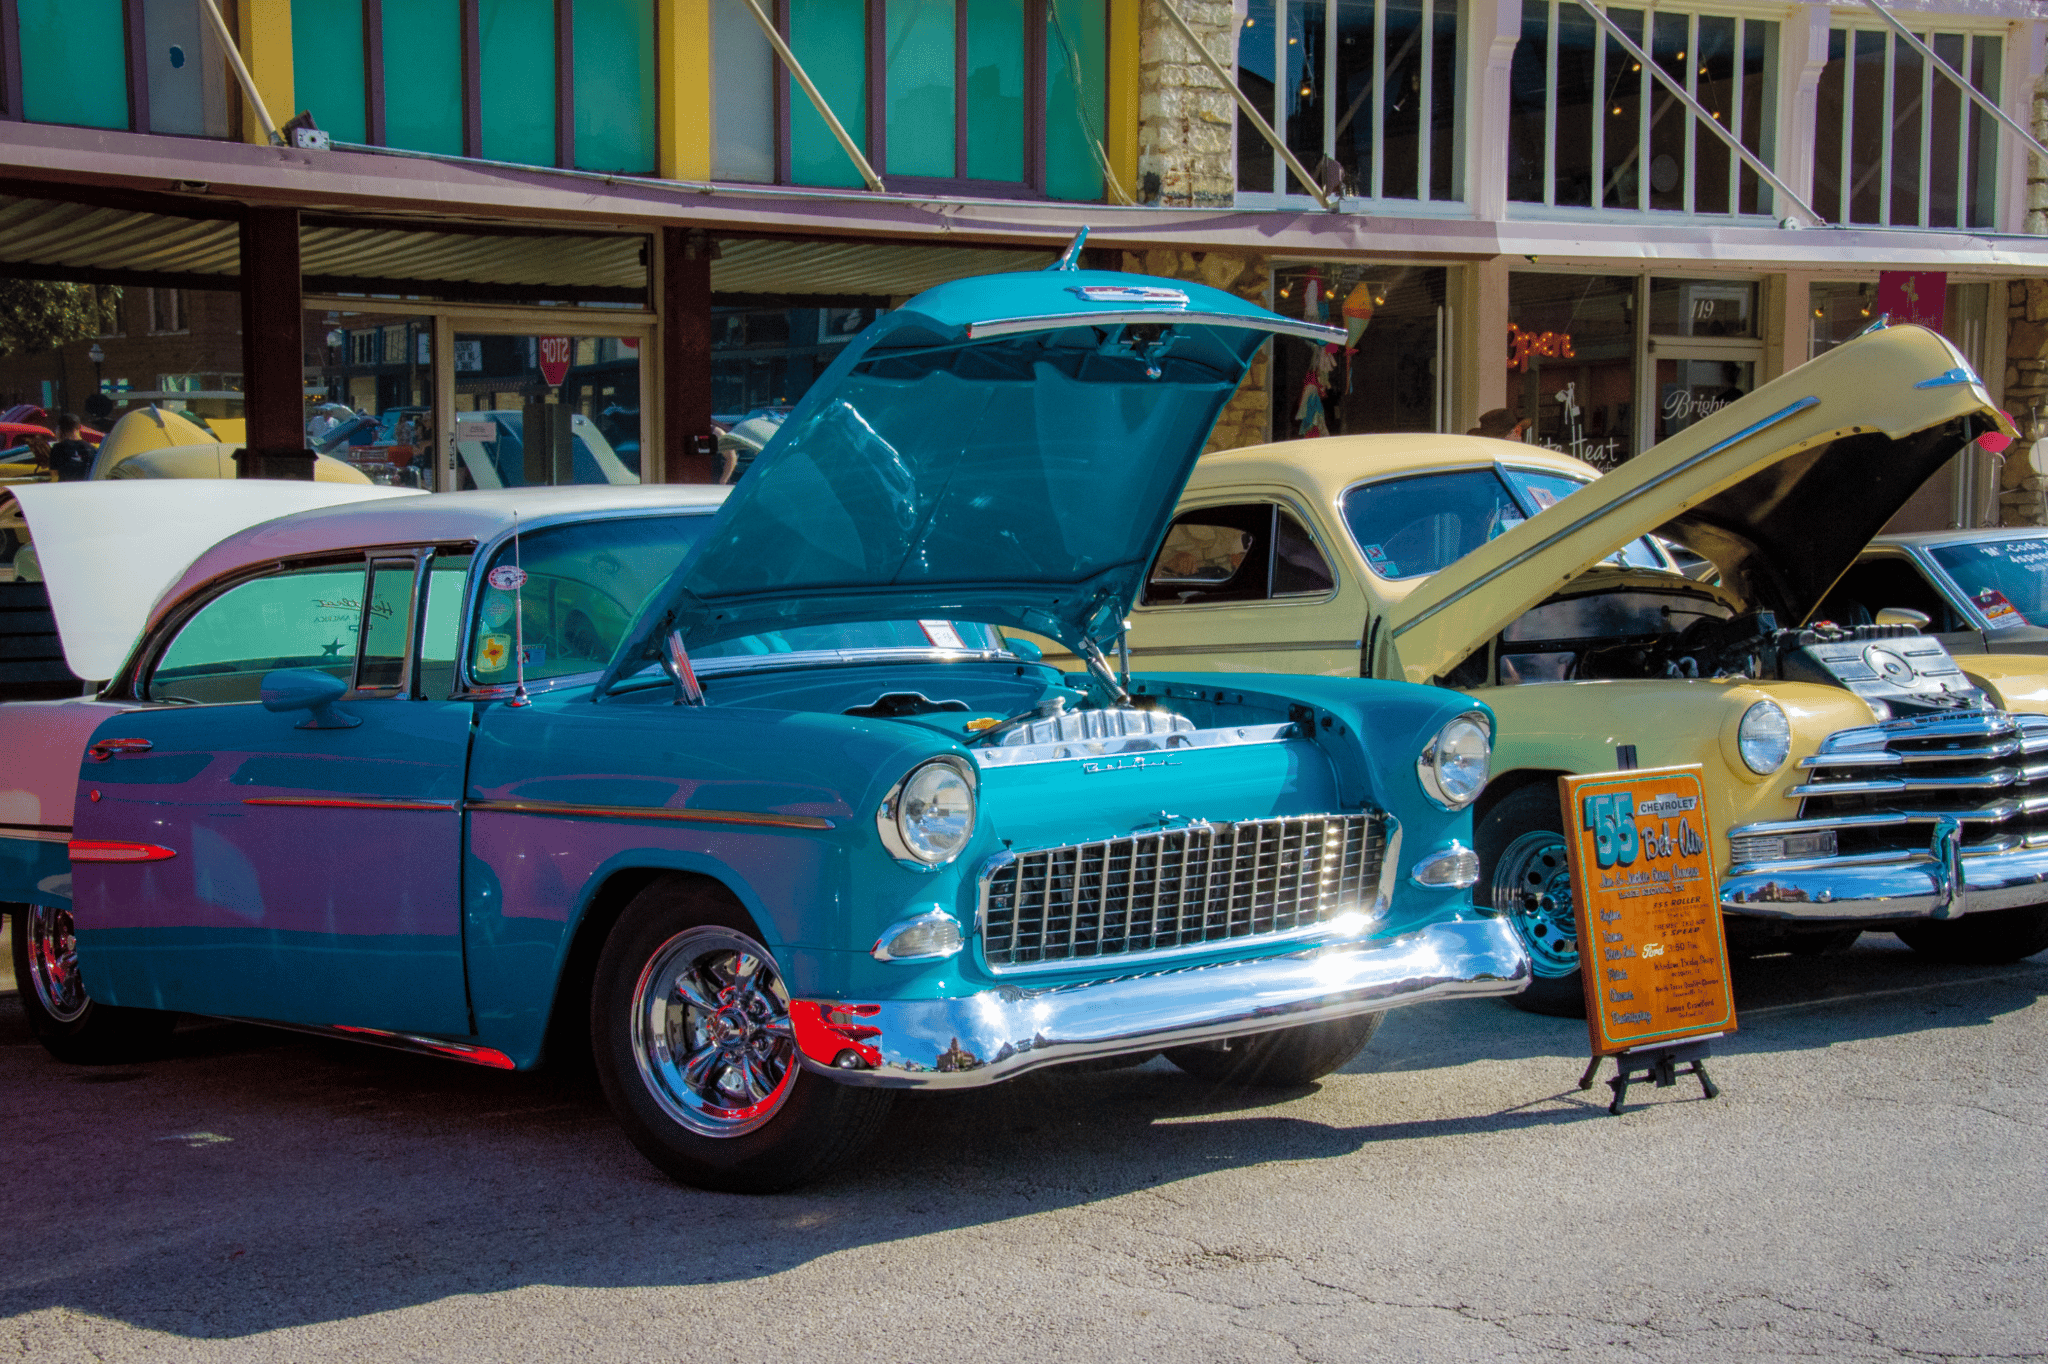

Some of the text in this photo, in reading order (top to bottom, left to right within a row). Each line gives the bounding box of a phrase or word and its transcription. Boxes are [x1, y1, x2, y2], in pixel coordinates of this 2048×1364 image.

[1690, 300, 1715, 319] 119
[1507, 322, 1576, 373] Open
[1568, 424, 1619, 462] Heat
[1640, 799, 1694, 813] CHEVROLET
[1619, 890, 1640, 899] LAKE
[1673, 884, 1685, 893] TX
[1671, 896, 1701, 906] ROLLER
[1642, 943, 1664, 959] Ford
